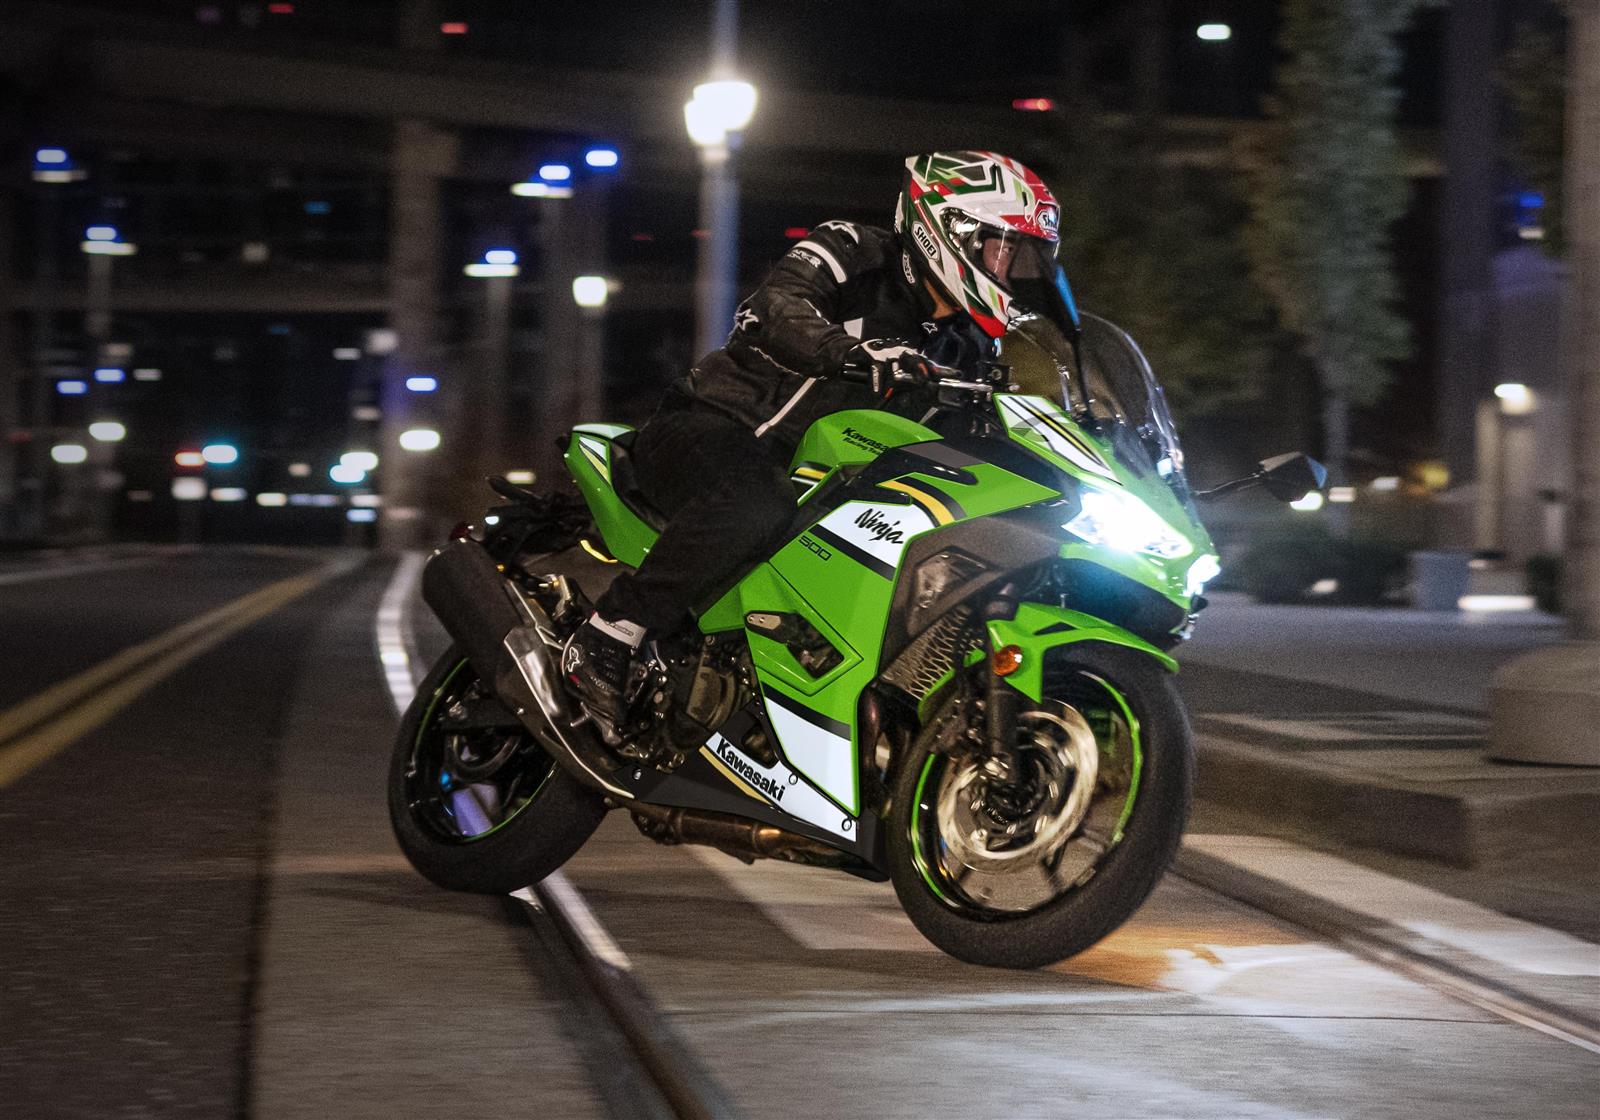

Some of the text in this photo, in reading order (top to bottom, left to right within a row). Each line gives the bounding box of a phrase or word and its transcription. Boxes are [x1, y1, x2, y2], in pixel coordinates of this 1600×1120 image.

[915, 226, 936, 257] SHOEI
[842, 427, 888, 451] Kawasa
[854, 508, 904, 544] Ninja
[799, 535, 832, 561] 500
[716, 738, 786, 802] Kawasaki
